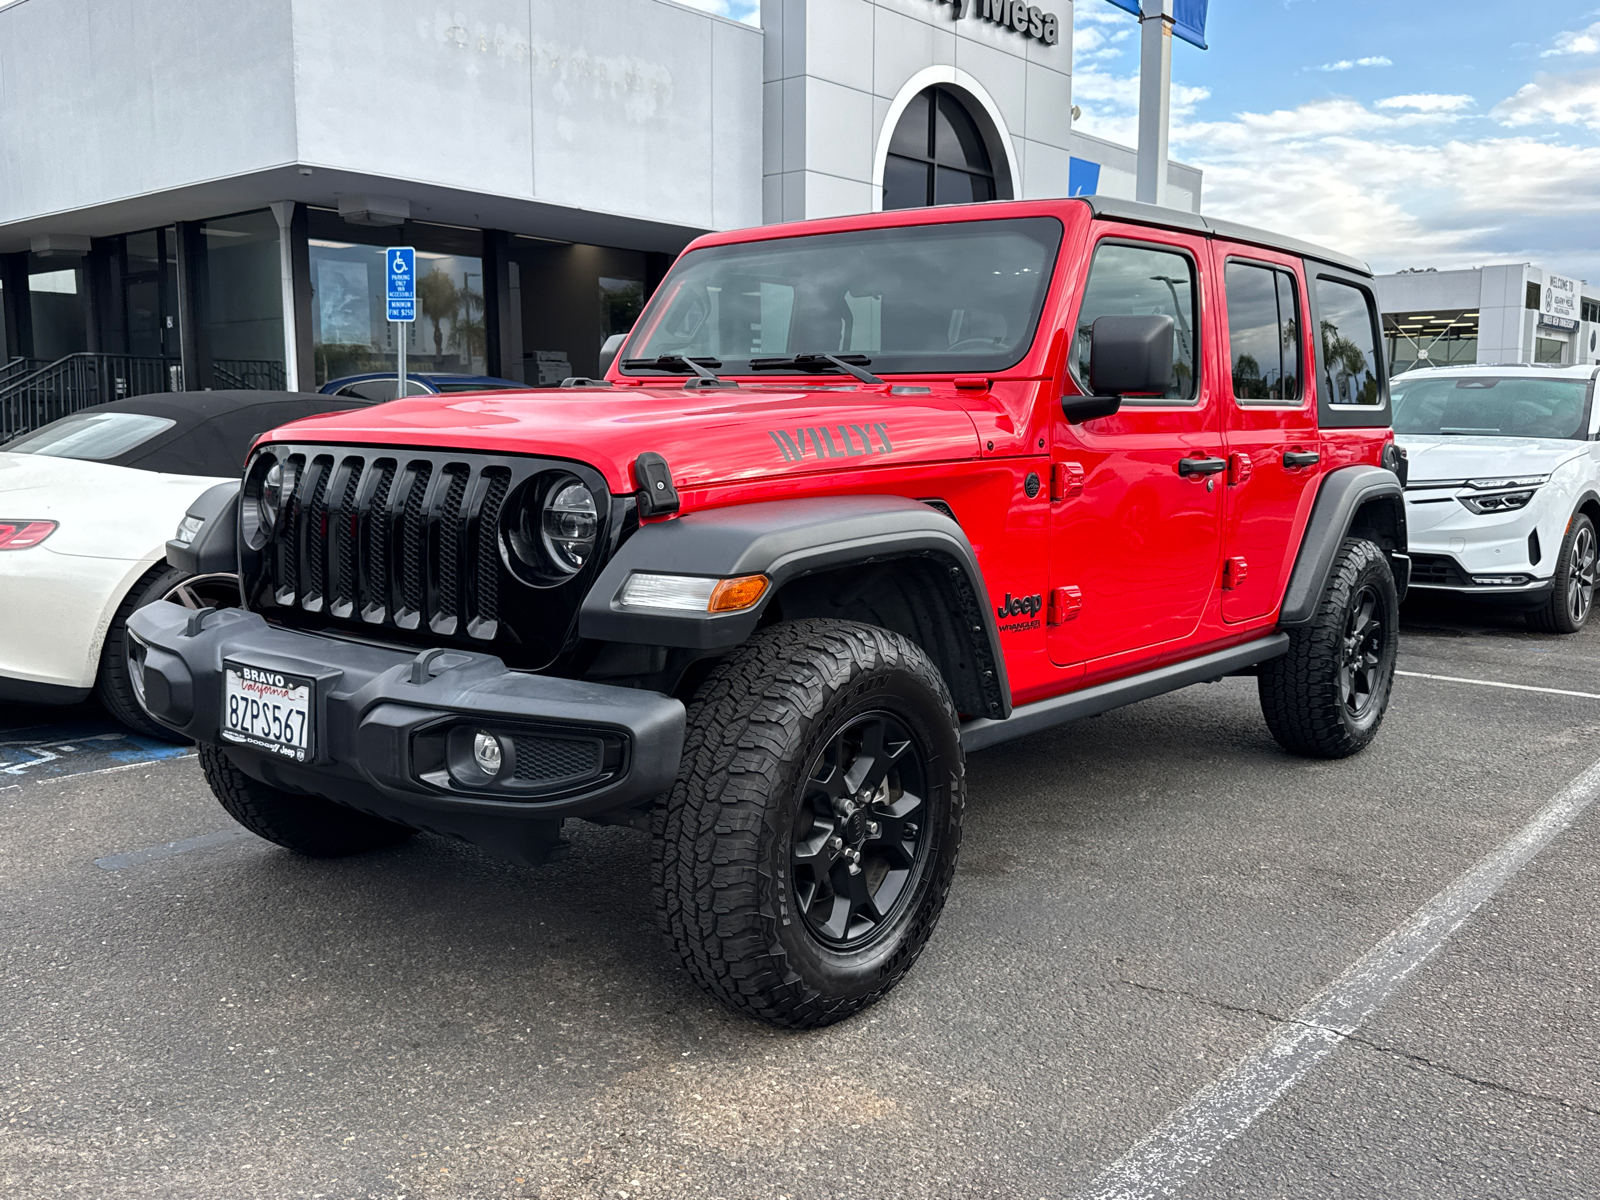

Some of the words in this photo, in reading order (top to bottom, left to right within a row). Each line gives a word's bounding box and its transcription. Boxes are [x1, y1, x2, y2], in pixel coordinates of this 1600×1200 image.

[1549, 275, 1568, 292] WELCOME
[389, 308, 400, 316] FINE
[400, 308, 414, 317] $250
[768, 422, 893, 463] WILLYS
[997, 592, 1042, 619] Jeep
[999, 619, 1041, 632] WRANGLER
[243, 667, 285, 687] BRAVO
[241, 679, 296, 701] California
[229, 693, 306, 747] 8ZPS567
[247, 737, 275, 749] DODGE
[280, 745, 296, 758] Jeep
